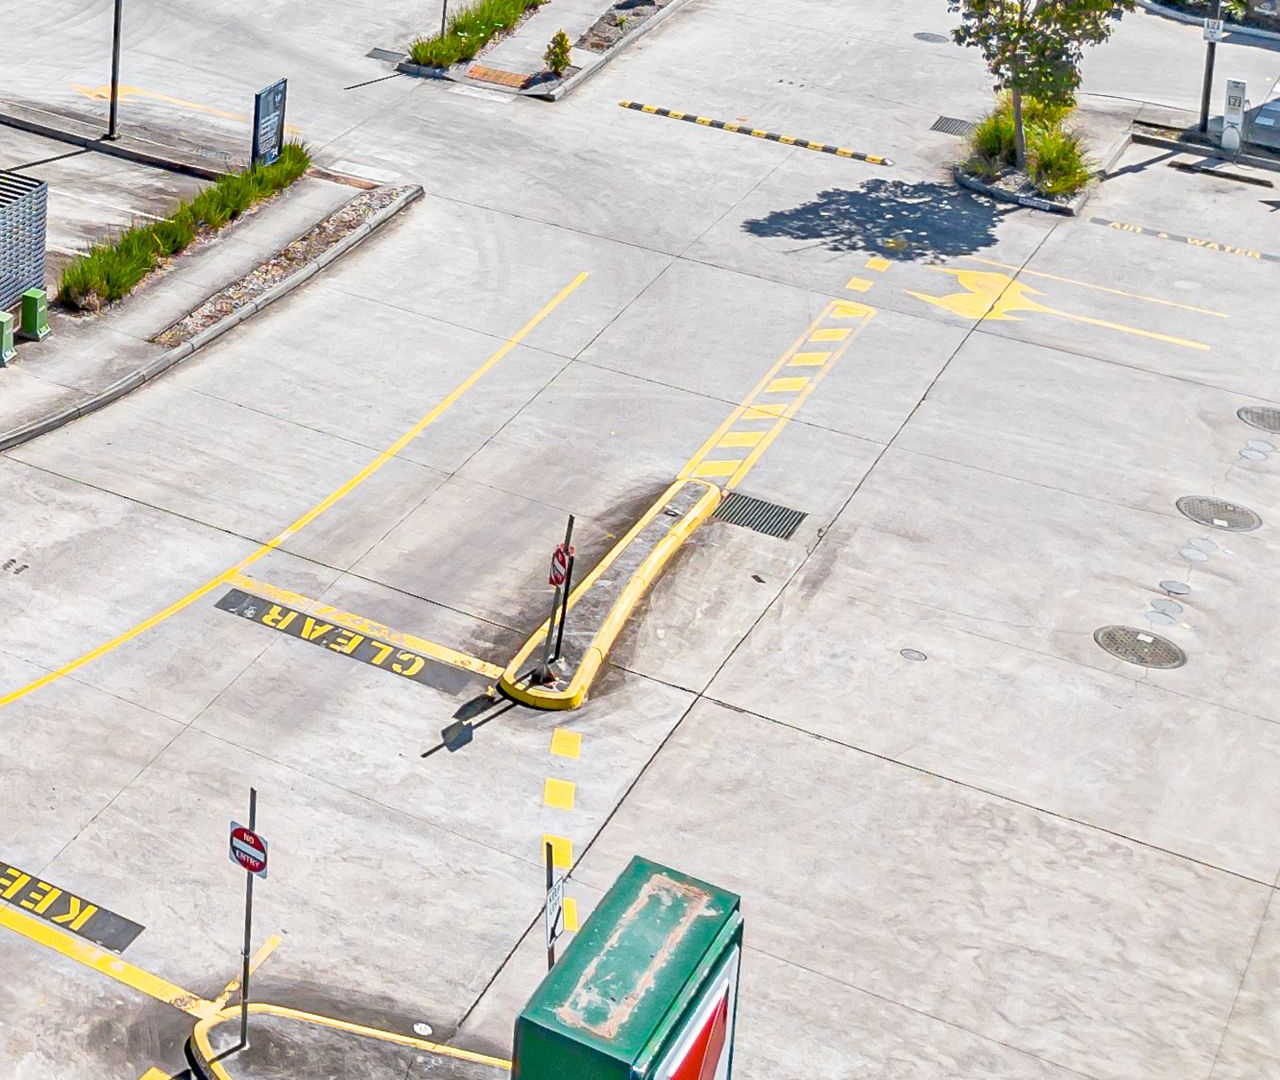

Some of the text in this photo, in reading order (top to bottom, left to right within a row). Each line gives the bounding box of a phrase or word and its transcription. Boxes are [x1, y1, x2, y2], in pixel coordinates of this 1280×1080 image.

[1187, 237, 1262, 260] WATER
[262, 602, 426, 678] CLEAR
[243, 832, 255, 844] NO
